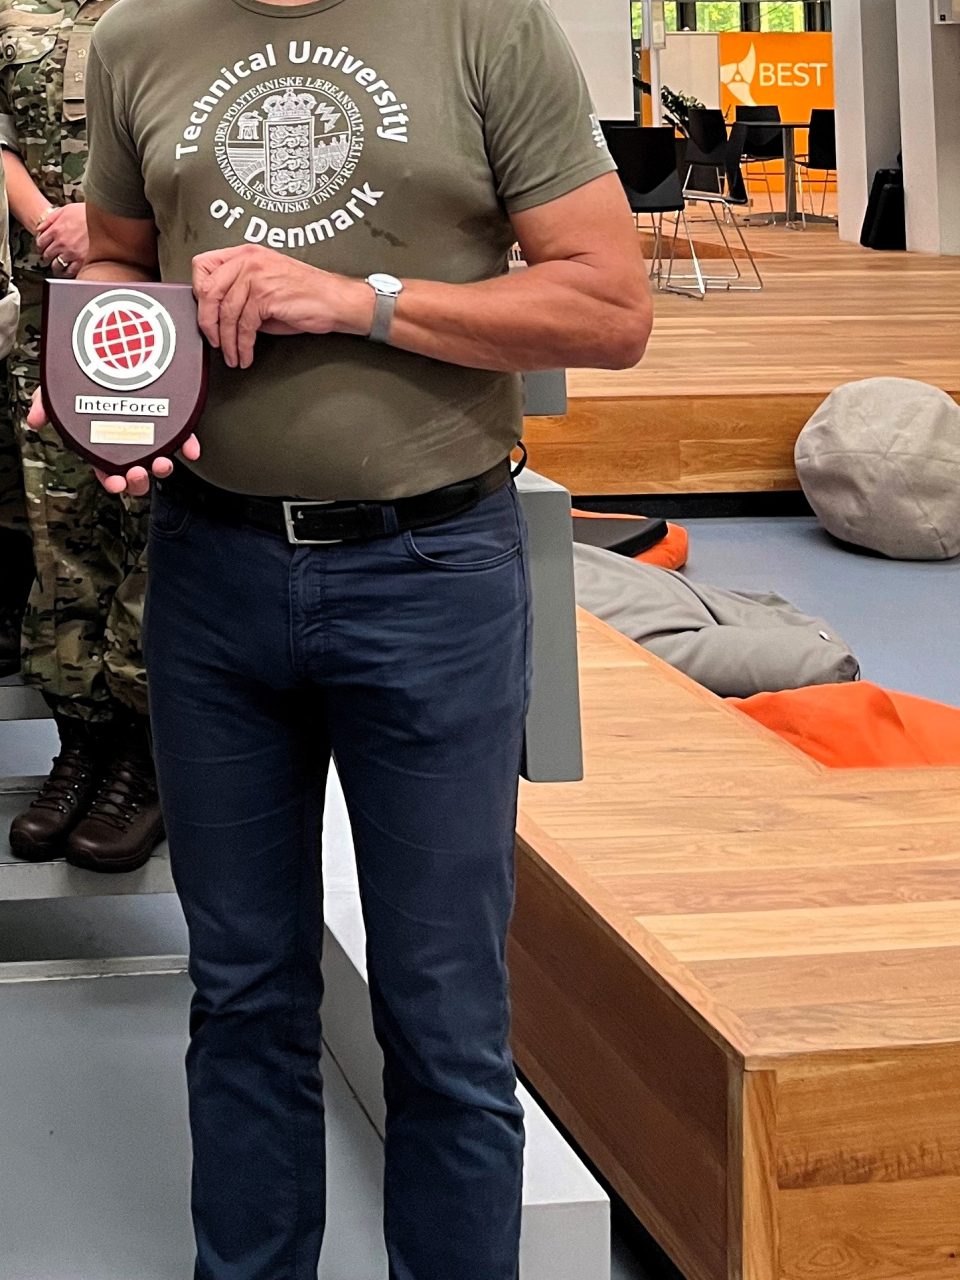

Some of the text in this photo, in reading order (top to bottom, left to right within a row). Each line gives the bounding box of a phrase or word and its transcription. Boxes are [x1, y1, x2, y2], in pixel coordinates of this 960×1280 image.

[758, 62, 828, 87] BEST
[214, 76, 365, 142] DEN POLYTEKNISKE LÆREANSTALT
[176, 40, 410, 248] Technical University of Denmark
[214, 135, 365, 213] DANMARKS TEKNISKE UNIVERSITET
[78, 398, 166, 413] InterForce
